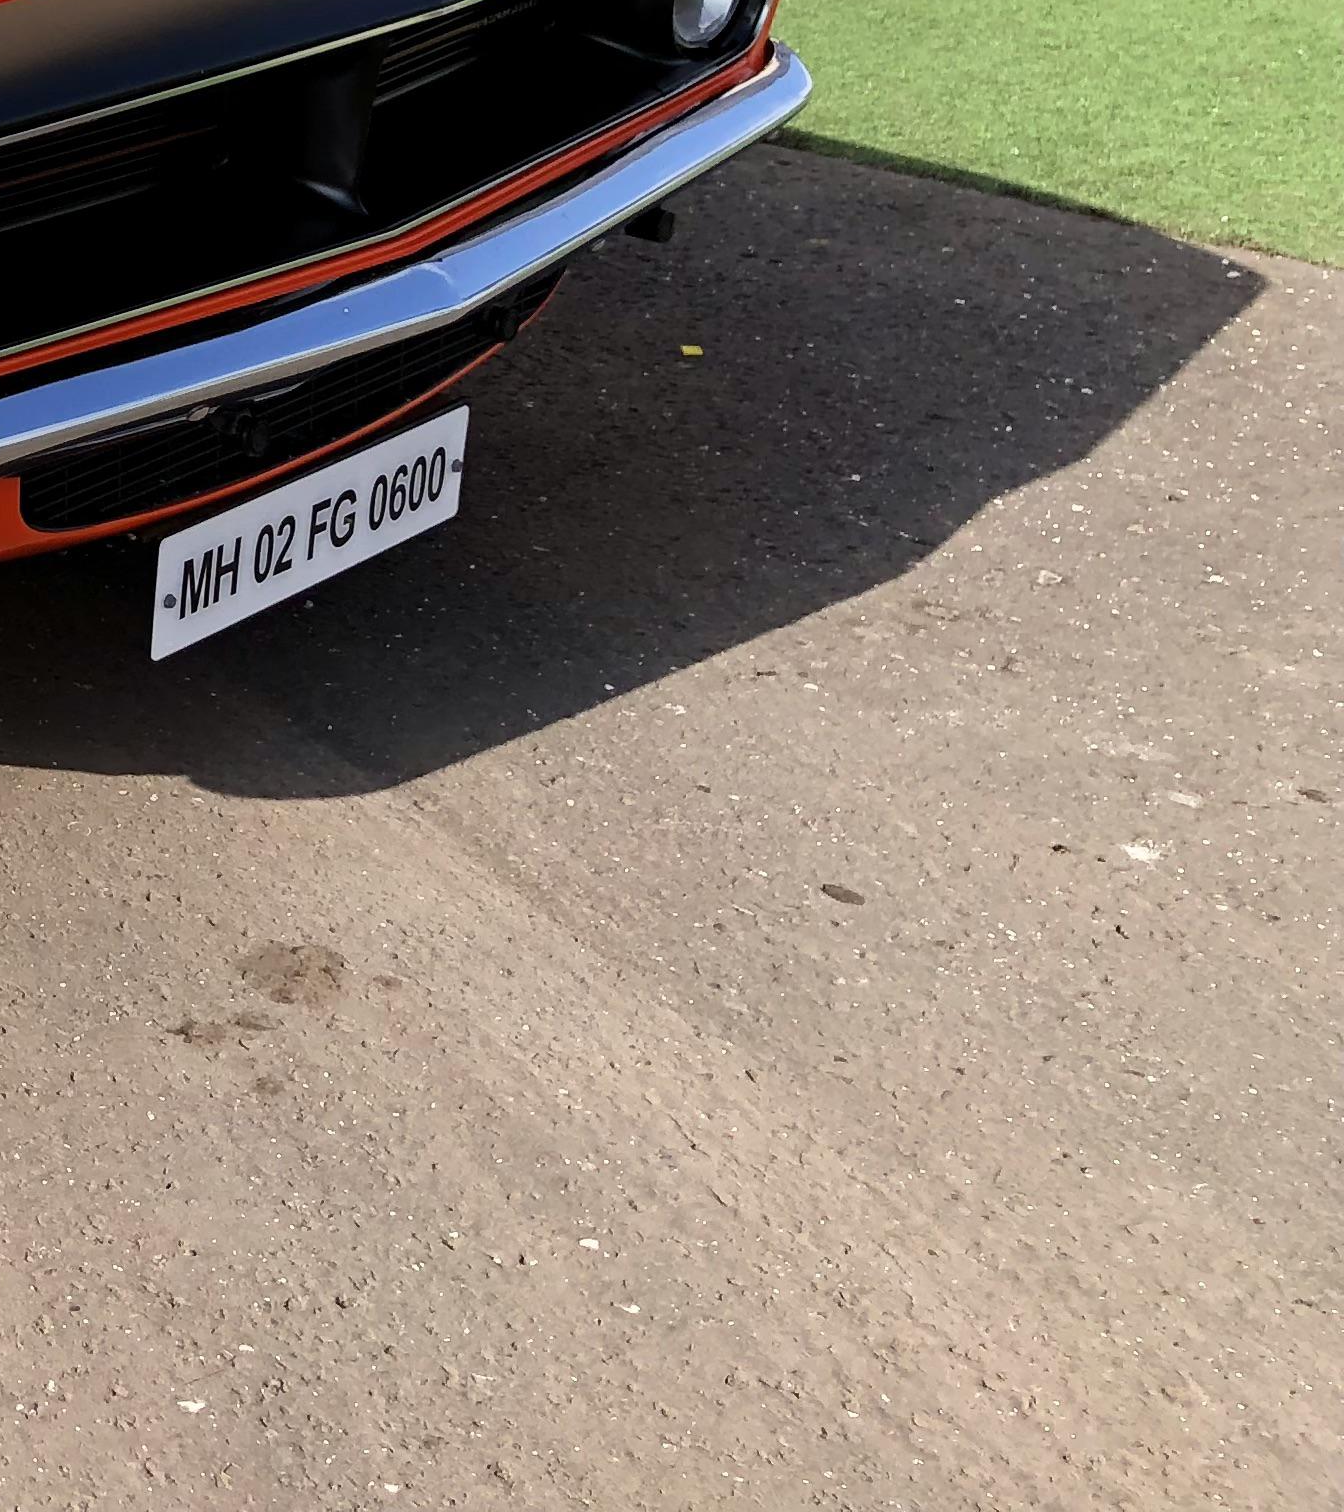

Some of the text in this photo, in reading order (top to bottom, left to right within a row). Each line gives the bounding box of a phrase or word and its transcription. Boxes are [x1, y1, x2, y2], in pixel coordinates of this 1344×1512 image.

[179, 446, 446, 620] MH 02 FG 0600
